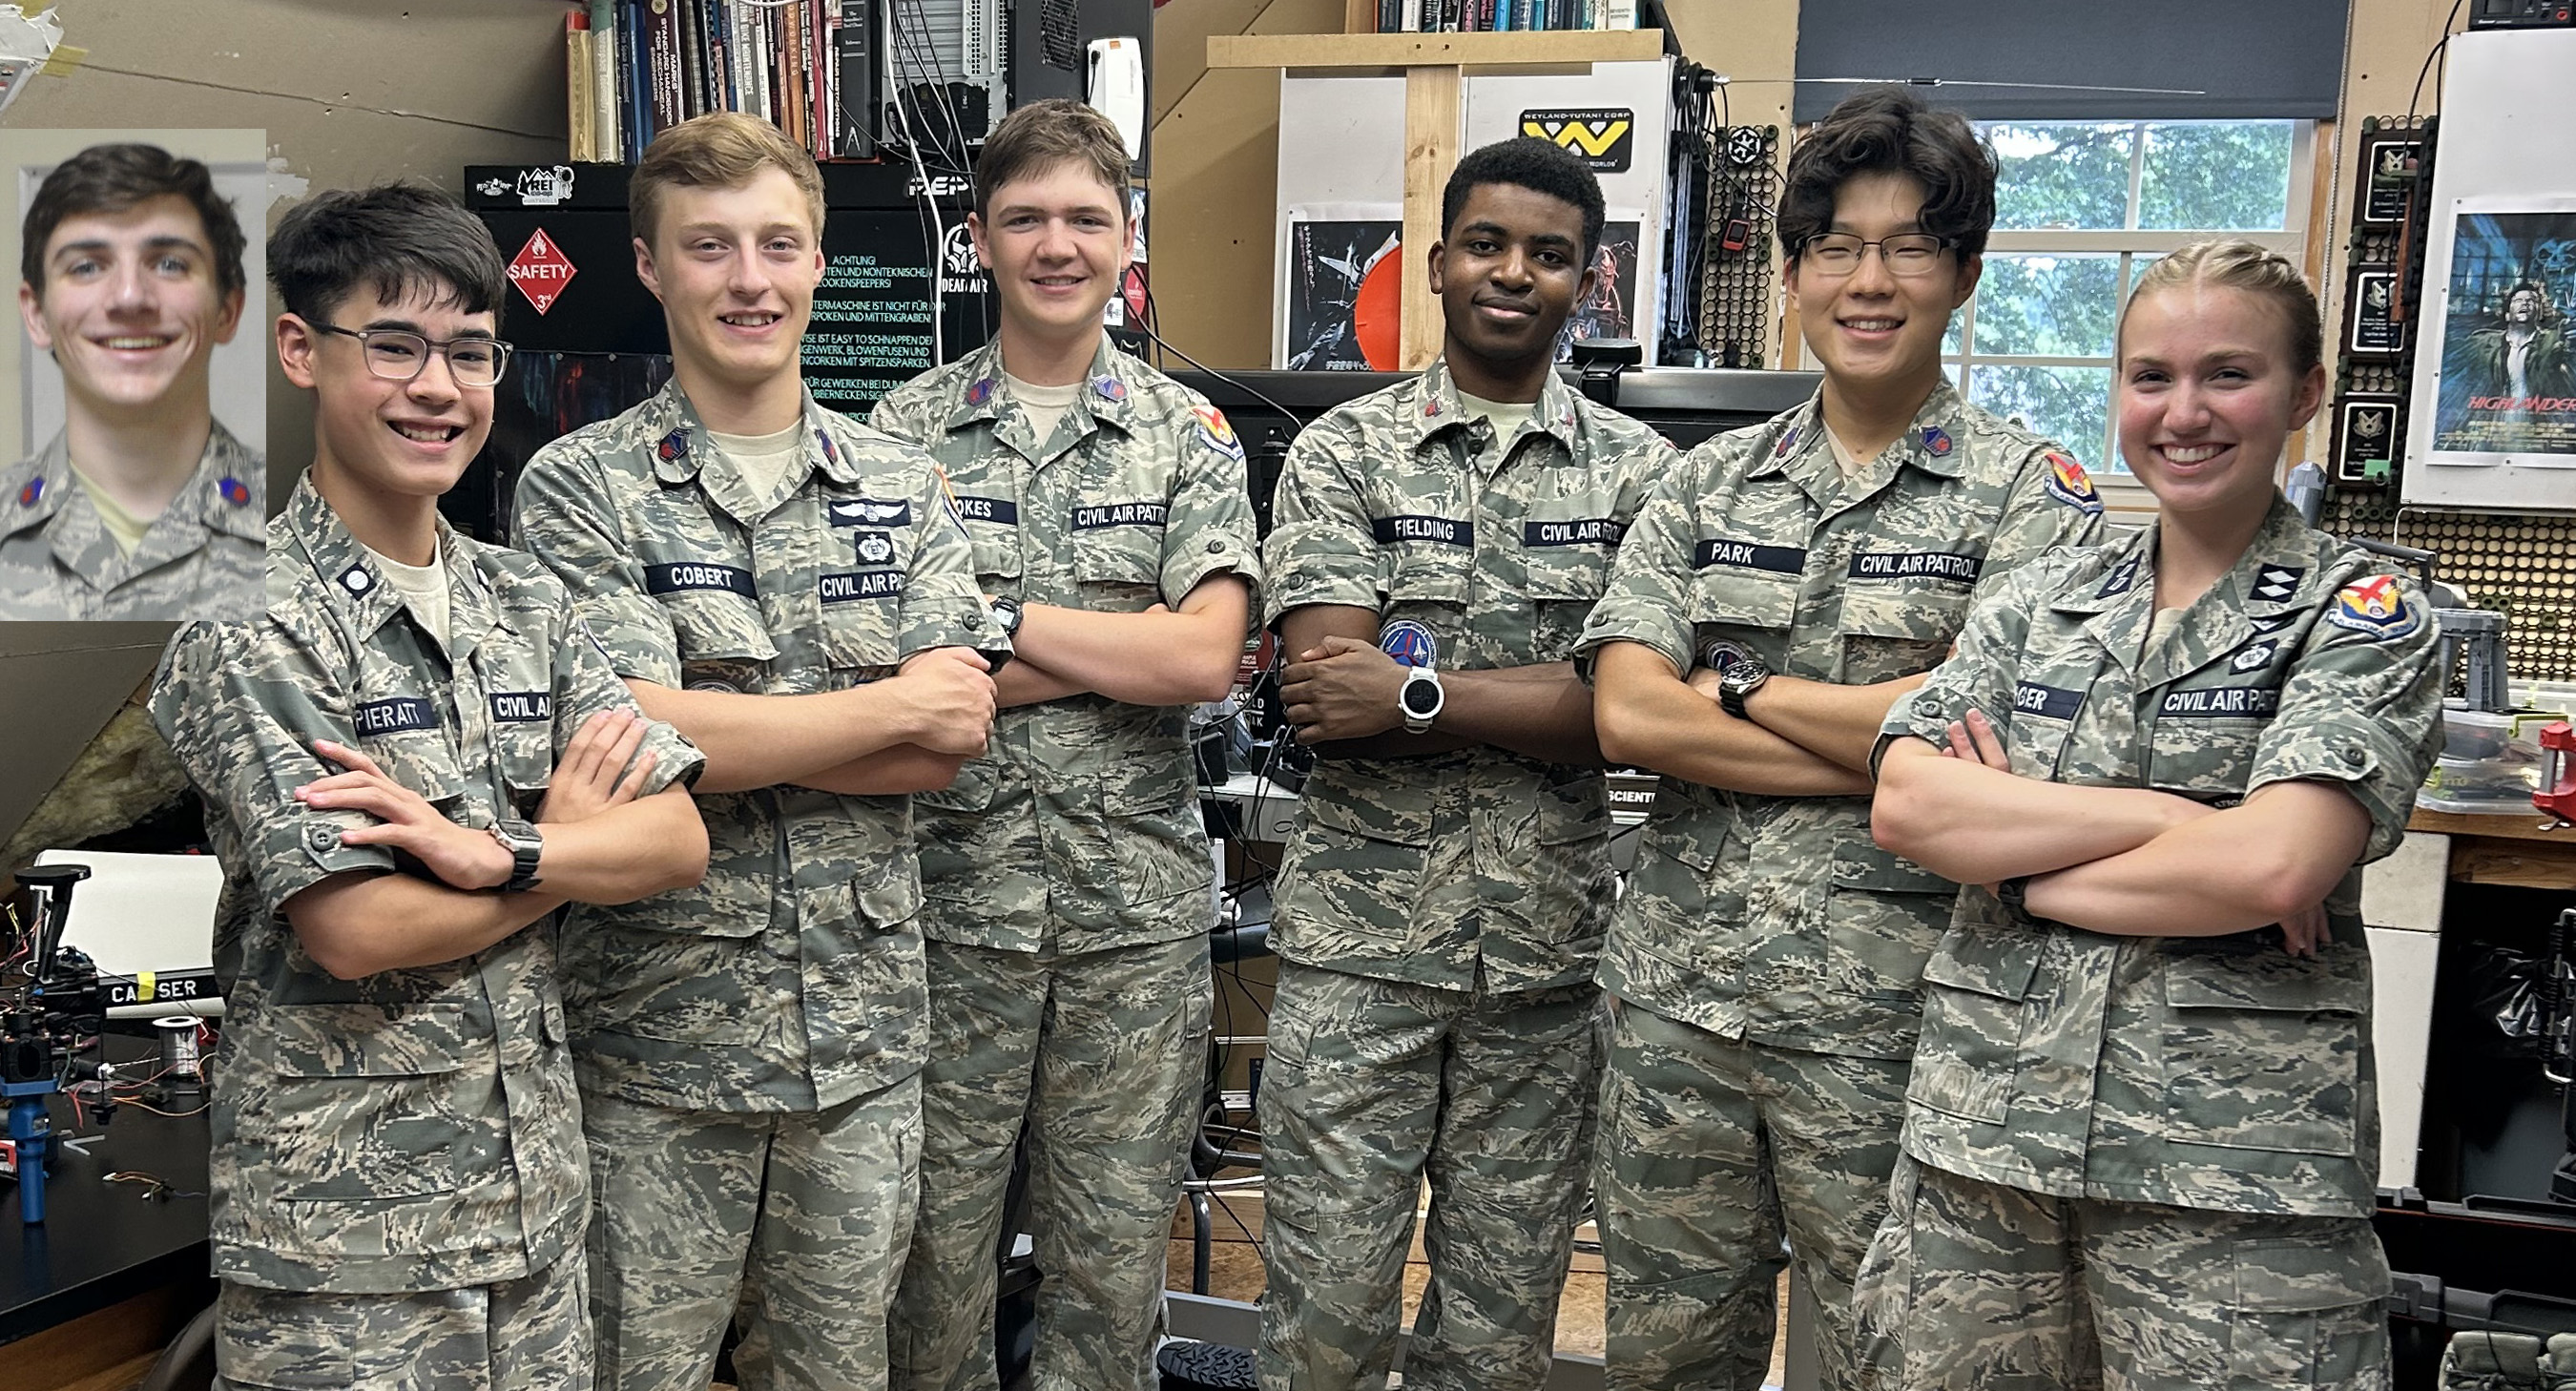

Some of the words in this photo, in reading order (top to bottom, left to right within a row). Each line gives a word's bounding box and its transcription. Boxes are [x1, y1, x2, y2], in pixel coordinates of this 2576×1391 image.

[530, 179, 553, 191] REI
[832, 256, 876, 265] ACHTUNG!
[509, 263, 569, 279] SAFETY
[843, 267, 862, 277] UND
[943, 278, 967, 292] DEAD
[537, 294, 551, 309] 3rd
[872, 301, 883, 311] IST
[885, 301, 910, 311] NICHT
[845, 313, 863, 322] UND
[818, 334, 830, 343] IST
[831, 334, 854, 344] EASY
[855, 335, 867, 344] TO
[868, 335, 918, 345] SCHNAPPEN
[910, 347, 929, 357] UND
[843, 357, 857, 366] MIT
[868, 380, 882, 389] BEI
[1078, 508, 1109, 526] CIVIL
[1111, 506, 1135, 523] AIR
[1395, 519, 1454, 540] FIELDING
[1542, 525, 1574, 542] CIVIL
[1577, 522, 1601, 540] AIR
[1712, 542, 1755, 565] PARK
[1860, 556, 1895, 574] CIVIL
[1897, 555, 1923, 573] AIR
[1925, 553, 1977, 578] PATROL
[671, 567, 734, 588] COBERT
[821, 576, 859, 597] CIVIL
[861, 574, 889, 595] AIR
[496, 696, 535, 717] CIVIL
[2164, 693, 2209, 712] CIVIL
[2212, 691, 2246, 712] AIR
